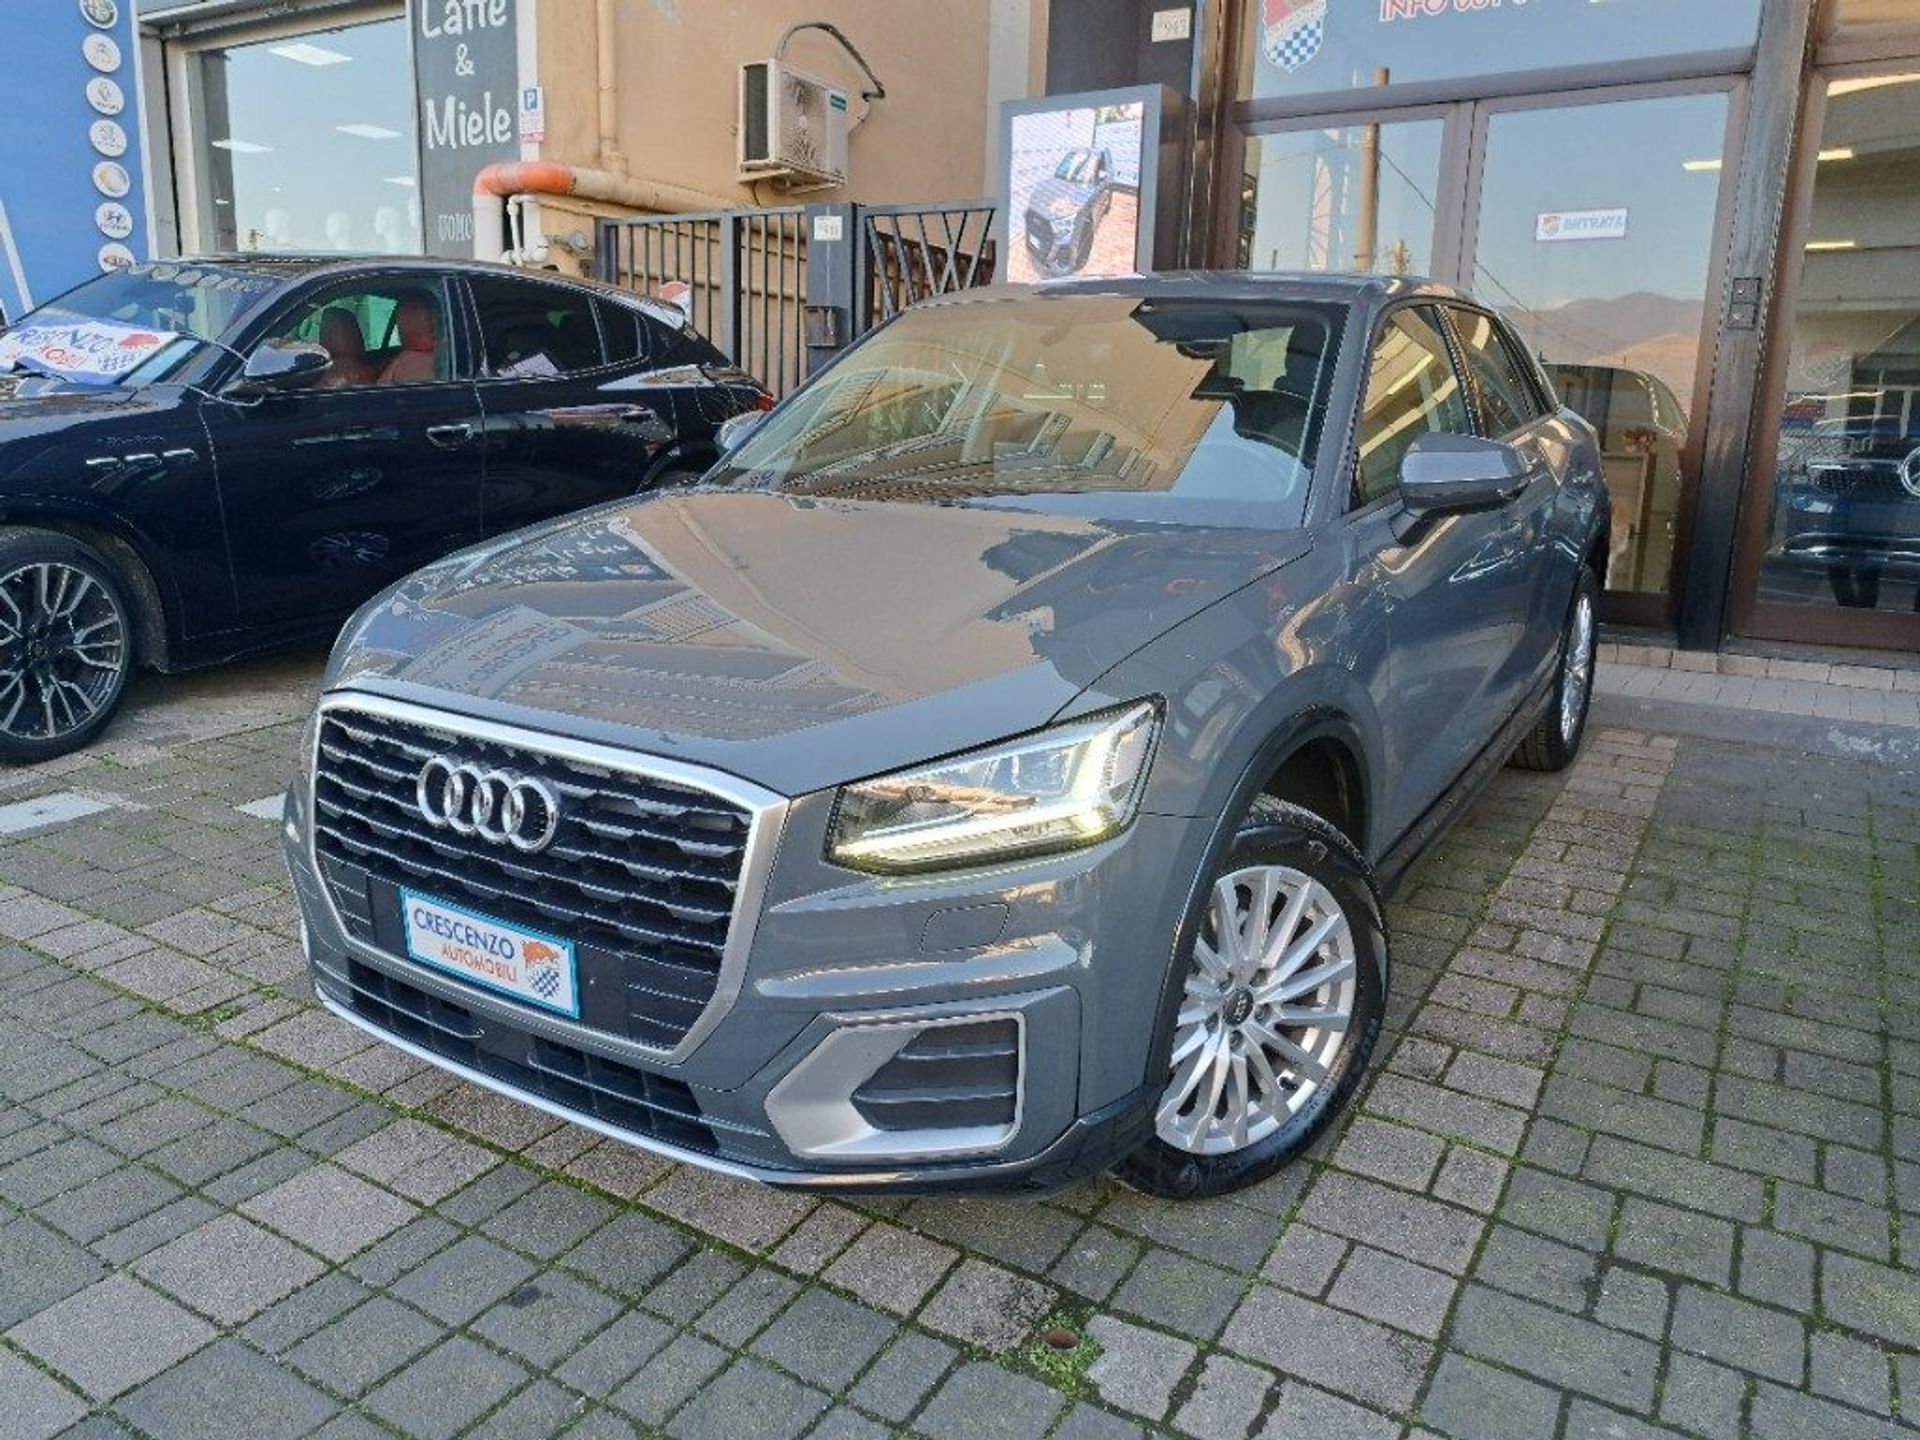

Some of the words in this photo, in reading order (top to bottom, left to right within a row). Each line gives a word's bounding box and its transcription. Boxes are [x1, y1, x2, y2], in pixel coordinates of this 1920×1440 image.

[455, 43, 475, 76] &
[526, 91, 536, 109] P
[426, 92, 512, 149] Miele
[413, 908, 515, 960] CRESCENZO
[442, 944, 517, 982] AUTOMOBILI
